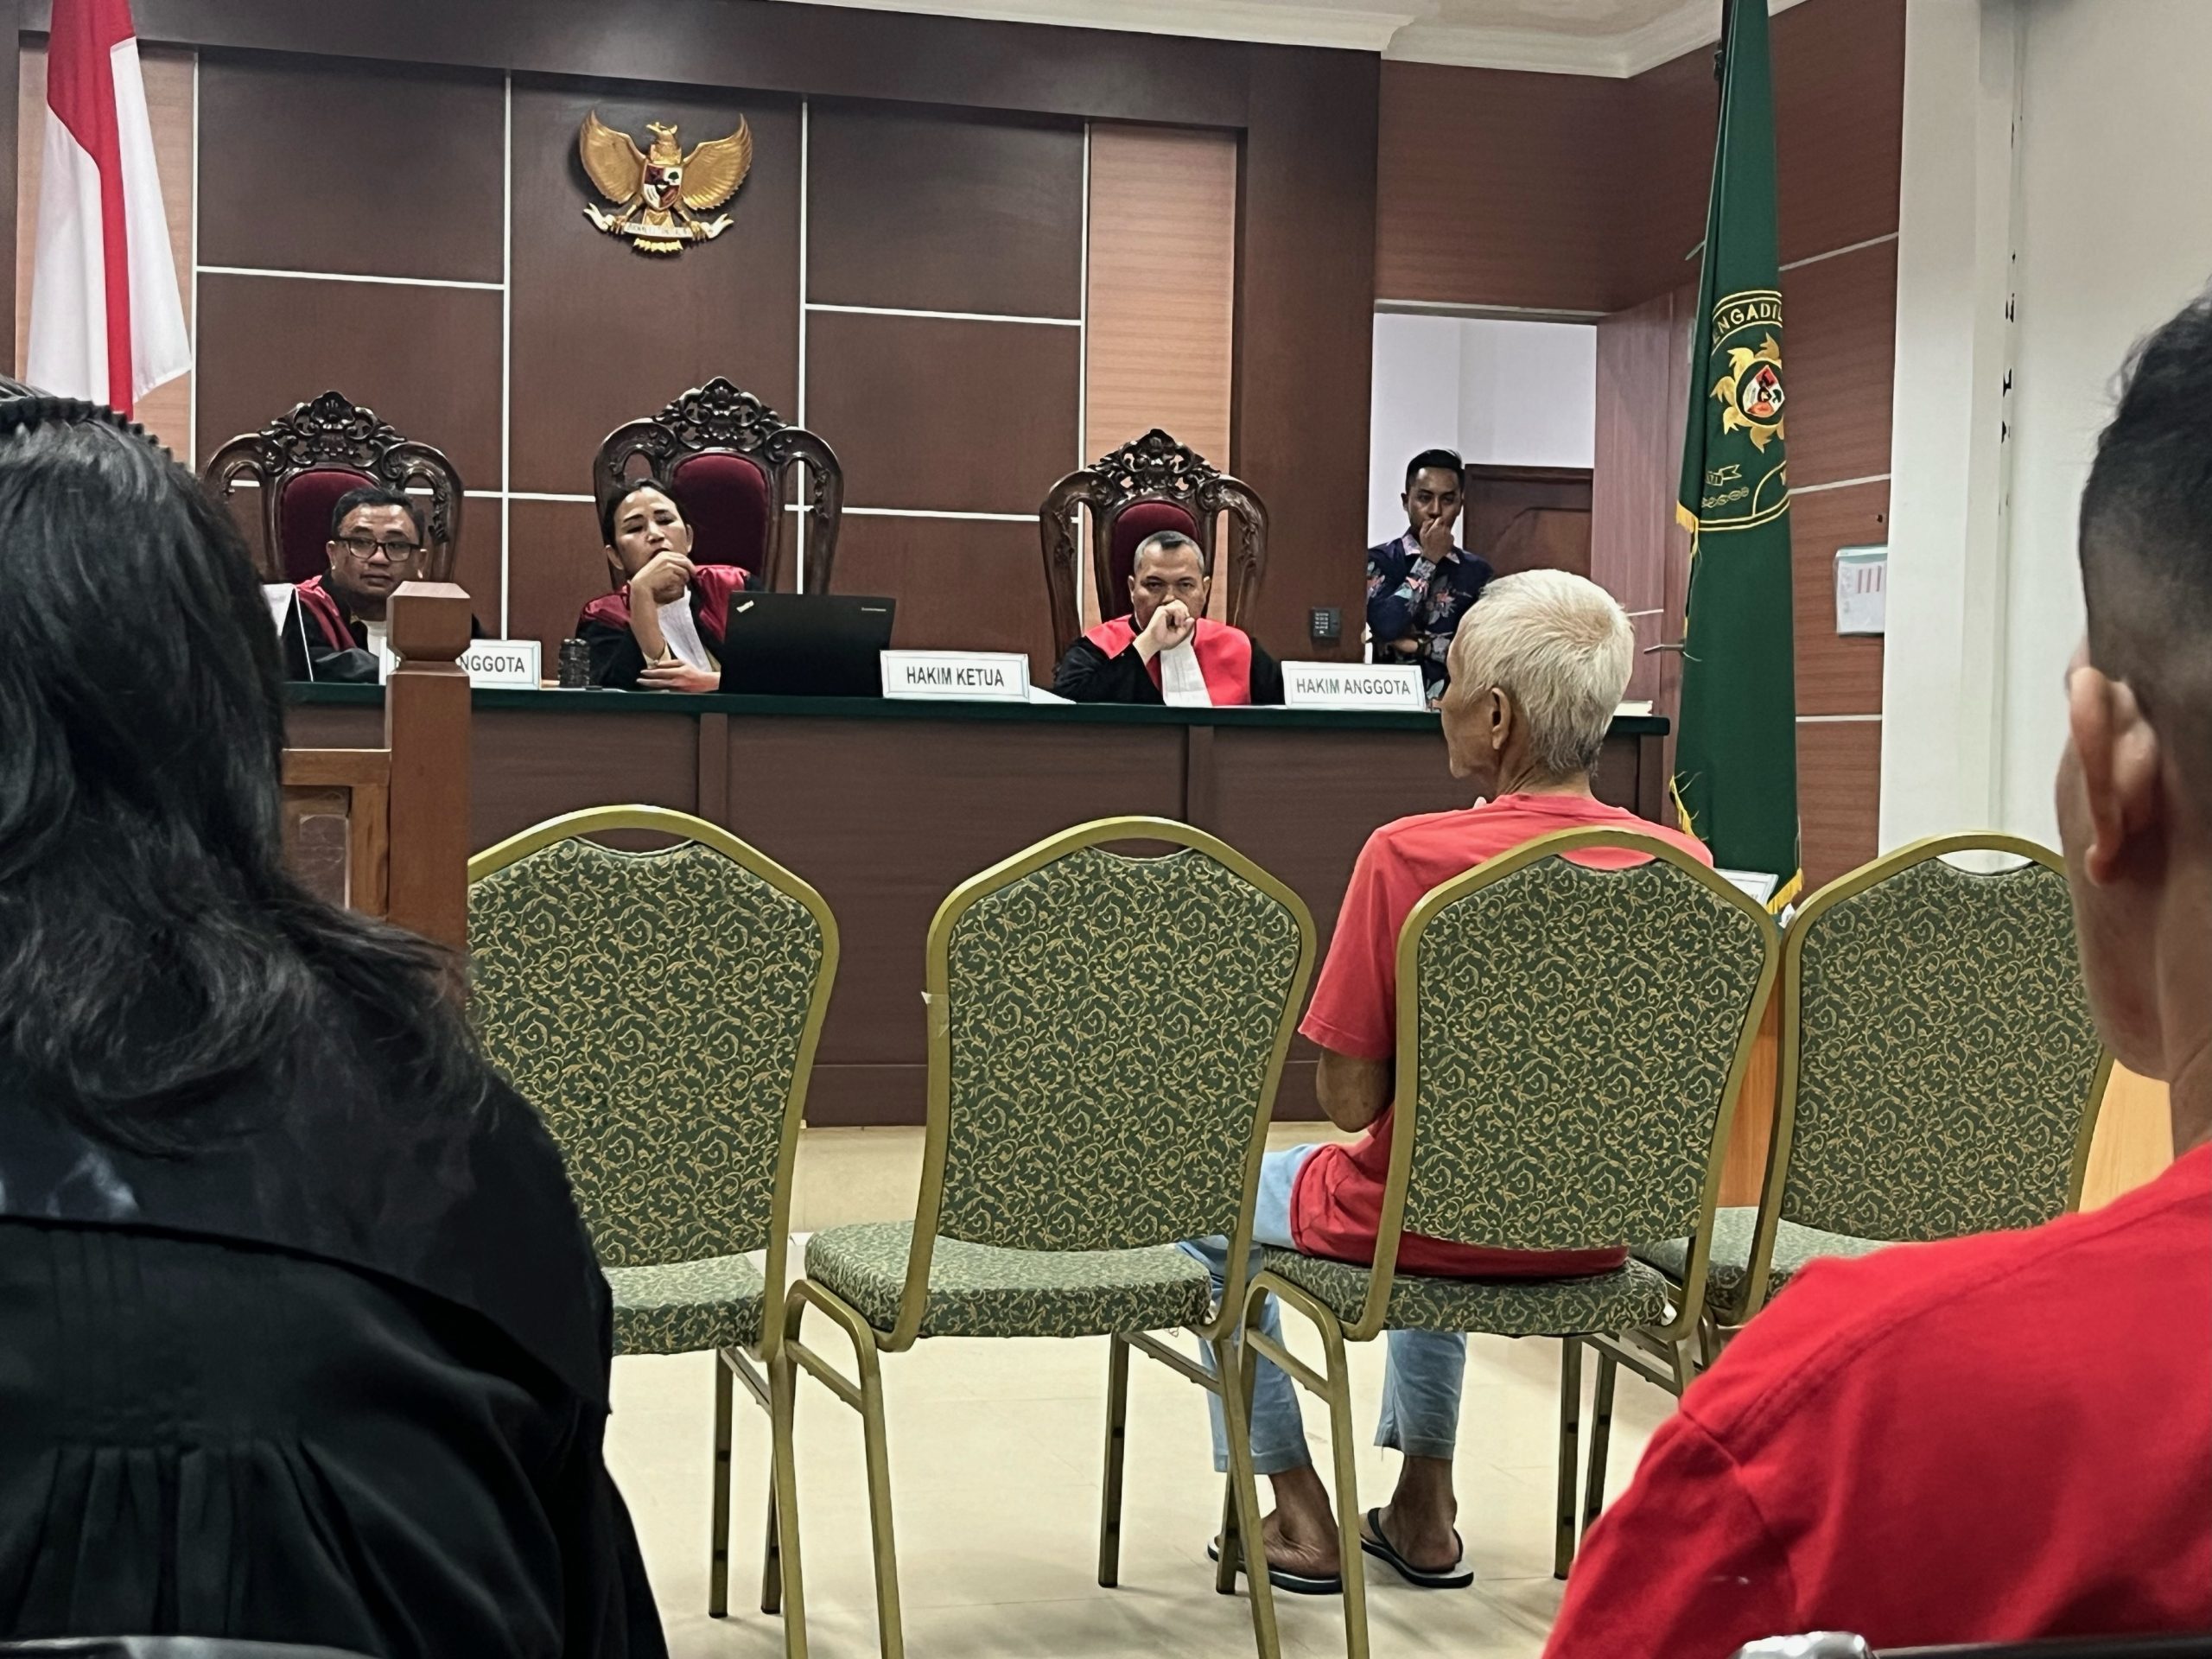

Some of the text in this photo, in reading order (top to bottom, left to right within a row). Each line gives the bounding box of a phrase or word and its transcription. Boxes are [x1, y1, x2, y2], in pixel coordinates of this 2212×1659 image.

[906, 666, 1005, 687] HAKIM KETUA
[1295, 677, 1411, 696] HAKIM ANGGOTA
